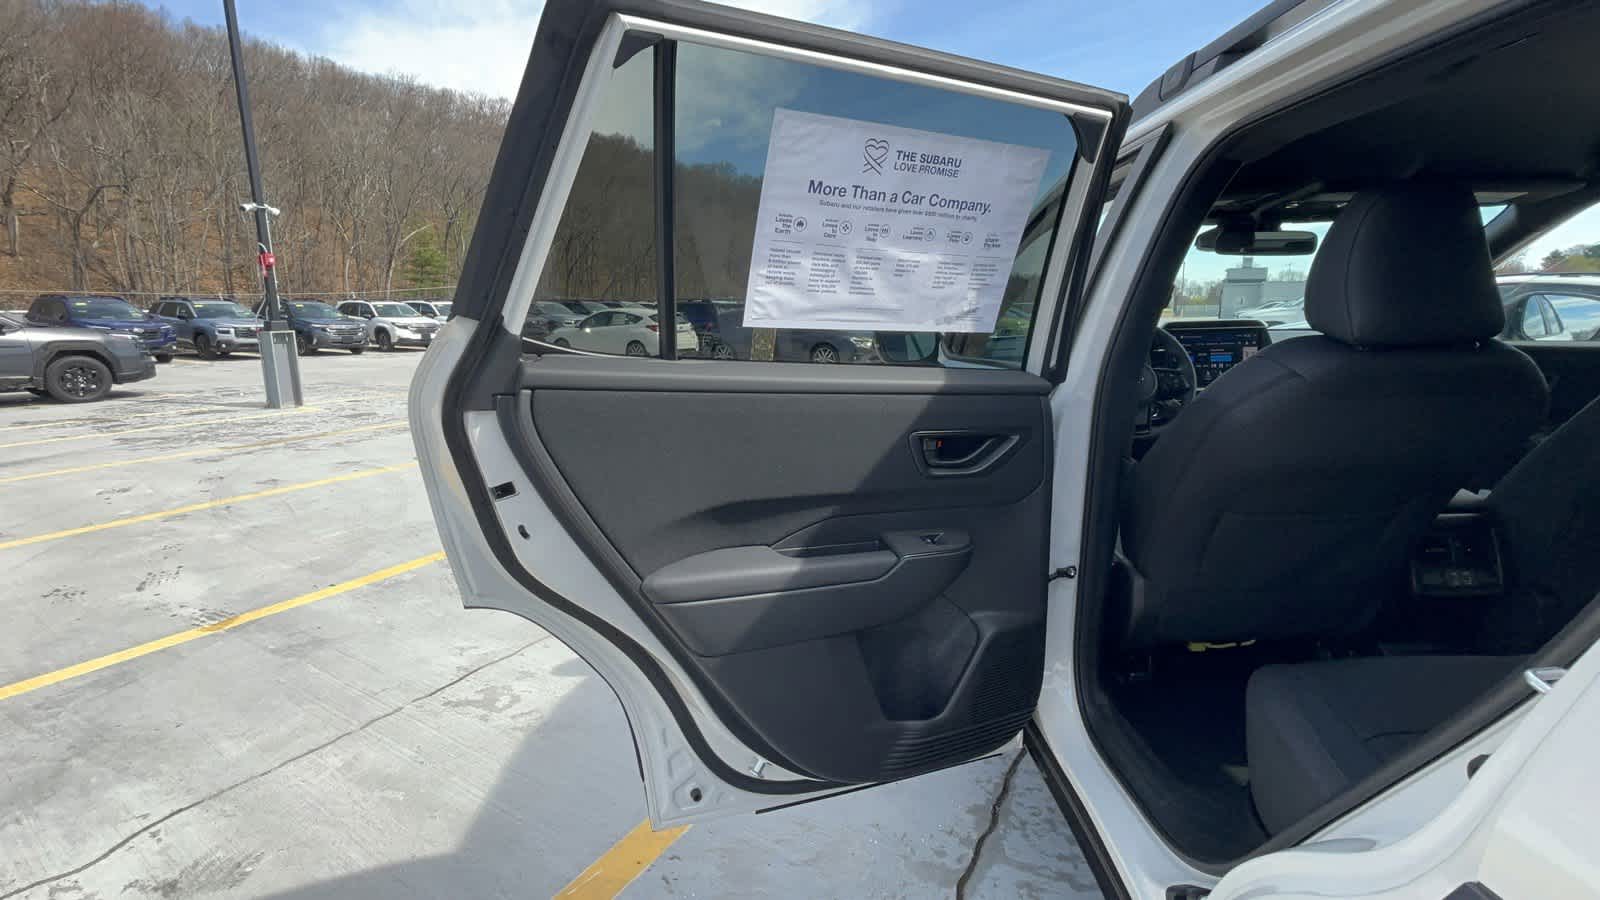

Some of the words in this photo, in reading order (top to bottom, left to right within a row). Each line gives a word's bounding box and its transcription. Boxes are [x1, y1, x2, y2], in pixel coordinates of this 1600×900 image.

[896, 150, 918, 162] THE
[920, 152, 962, 169] SUBARU
[894, 162, 917, 173] LOVE
[919, 165, 960, 178] PROMISE
[808, 179, 847, 198] More
[852, 185, 887, 203] Than
[890, 192, 899, 204] a
[902, 190, 925, 206] Car
[929, 193, 992, 215] Company.
[819, 199, 840, 208] Subaru
[776, 216, 793, 224] Loves
